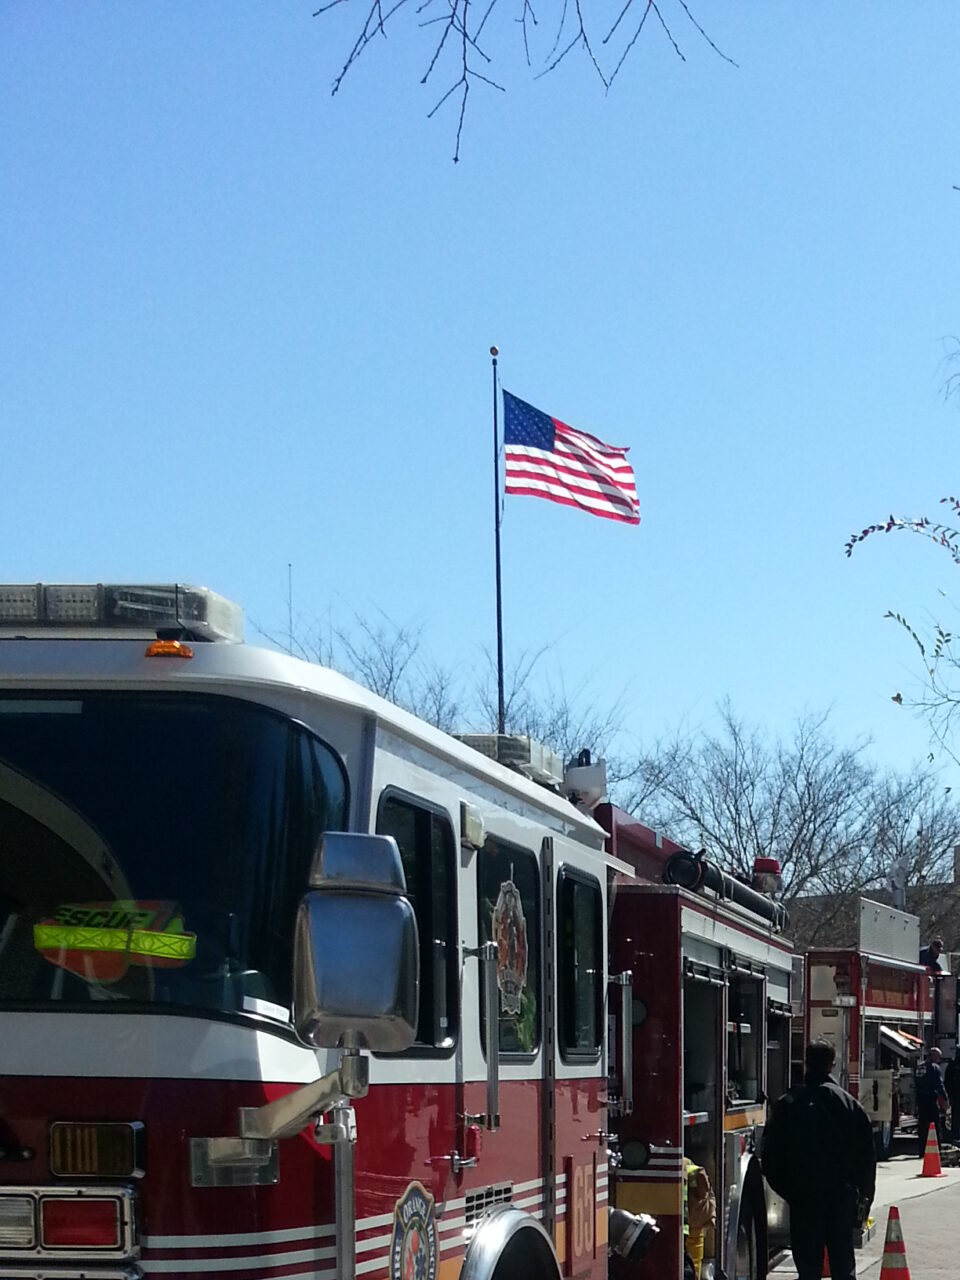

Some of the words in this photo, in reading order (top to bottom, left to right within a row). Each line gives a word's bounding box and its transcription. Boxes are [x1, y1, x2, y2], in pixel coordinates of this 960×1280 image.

[55, 905, 148, 929] ESCUE
[403, 1197, 427, 1223] ORANGE
[573, 1165, 593, 1257] 65
